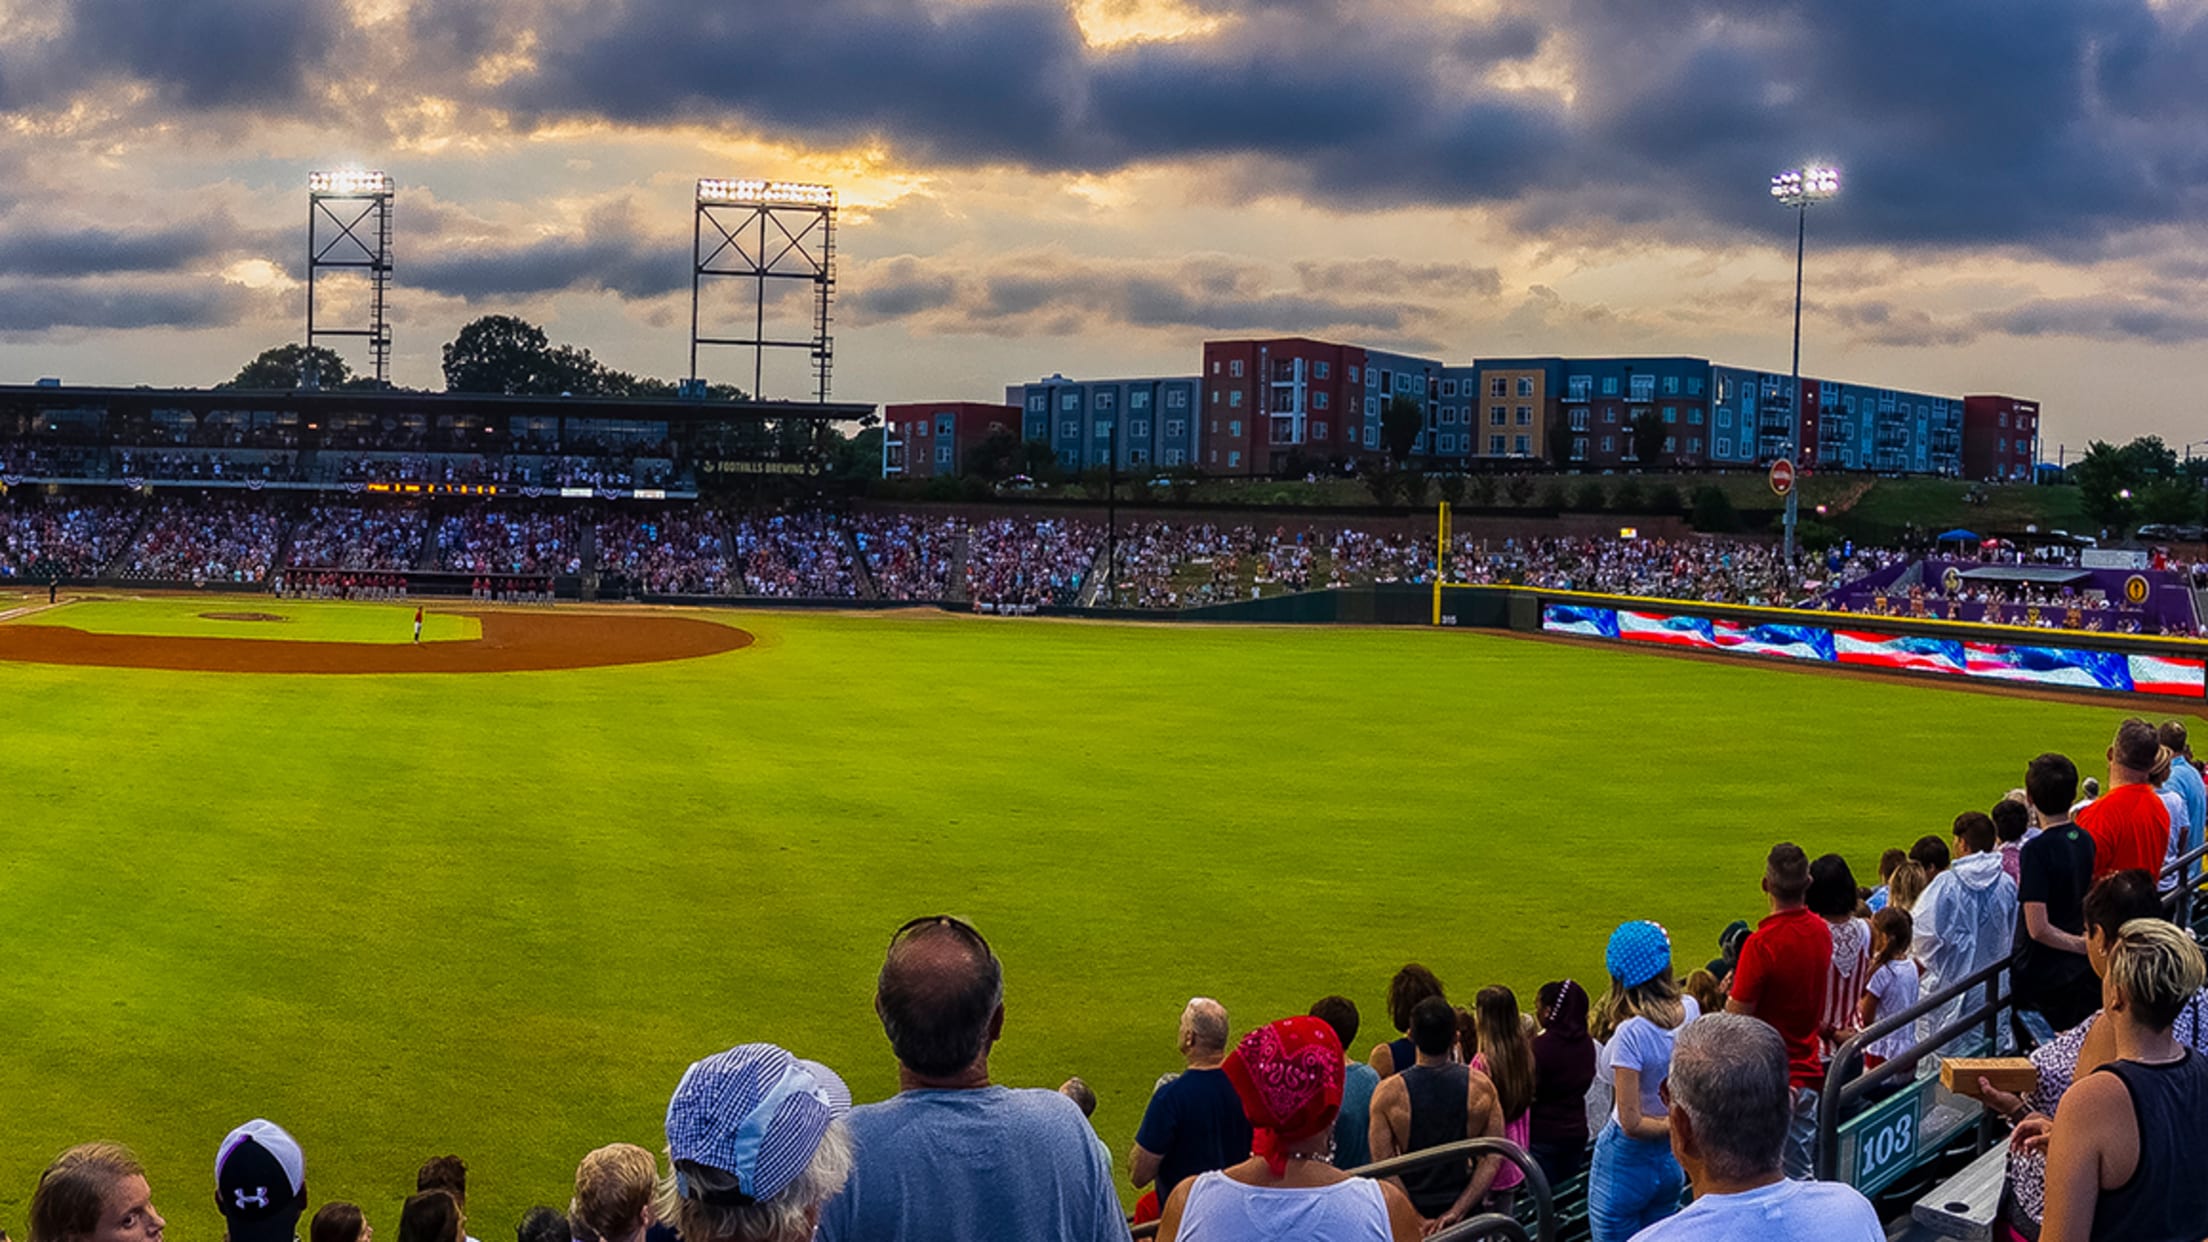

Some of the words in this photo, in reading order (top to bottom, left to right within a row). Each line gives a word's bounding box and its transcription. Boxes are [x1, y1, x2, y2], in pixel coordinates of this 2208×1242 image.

[718, 461, 763, 473] FOOTHILLS
[765, 462, 805, 475] BREWING
[1861, 1113, 1912, 1176] 103
